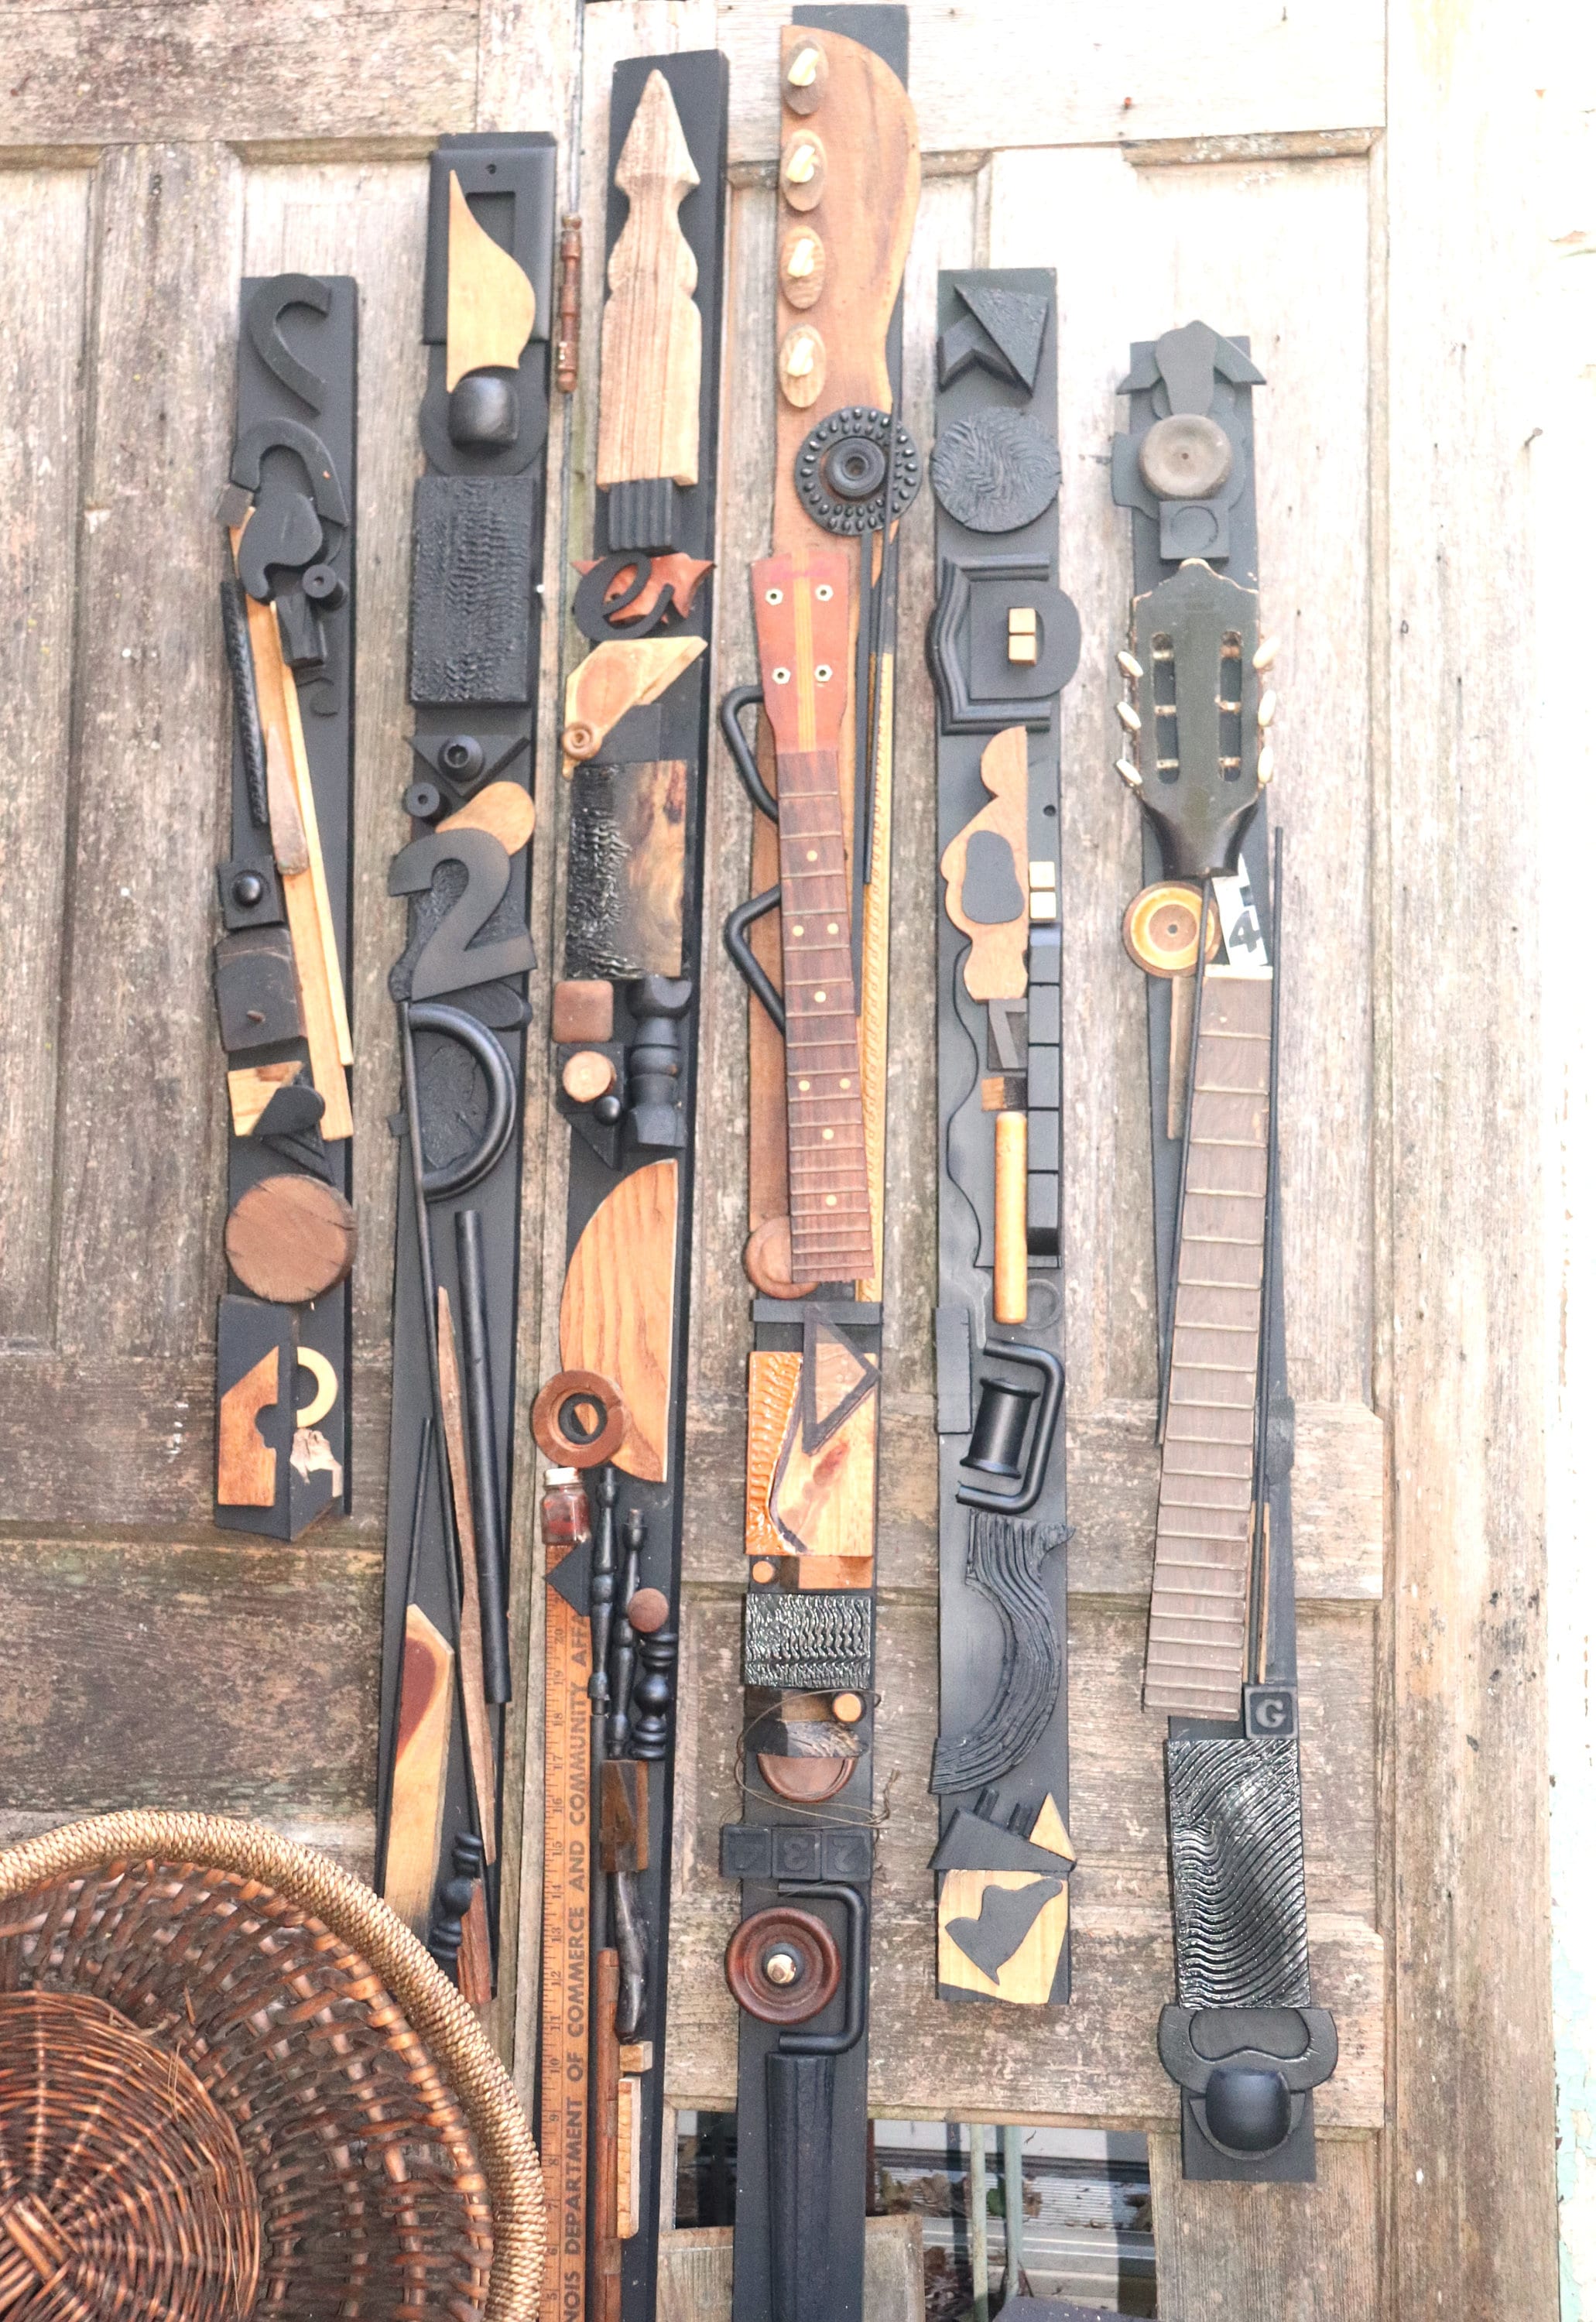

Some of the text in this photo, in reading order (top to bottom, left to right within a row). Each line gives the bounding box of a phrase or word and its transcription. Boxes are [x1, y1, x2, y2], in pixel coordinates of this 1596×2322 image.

[388, 827, 538, 1002] 2
[1229, 910, 1262, 953] 4
[553, 1628, 564, 1644] 20
[553, 1670, 563, 1686] 19
[553, 1712, 563, 1728] 18
[1255, 1699, 1286, 1728] G
[569, 1681, 587, 1826] COMMUNITY
[553, 1755, 563, 1770] 17
[553, 1798, 563, 1813] 16
[553, 1841, 563, 1857] 15
[568, 1840, 586, 1892] AND
[552, 1884, 562, 1899] 14
[551, 1927, 562, 1943] 13
[550, 1971, 562, 1986] 12
[567, 1906, 585, 2038] COMMERCE
[550, 2015, 561, 2030] 11
[550, 2058, 560, 2074] 10
[567, 2052, 584, 2082] OF
[564, 2097, 583, 2255] DEPARTMENT
[546, 2247, 558, 2255] 6
[546, 2292, 558, 2300] 5
